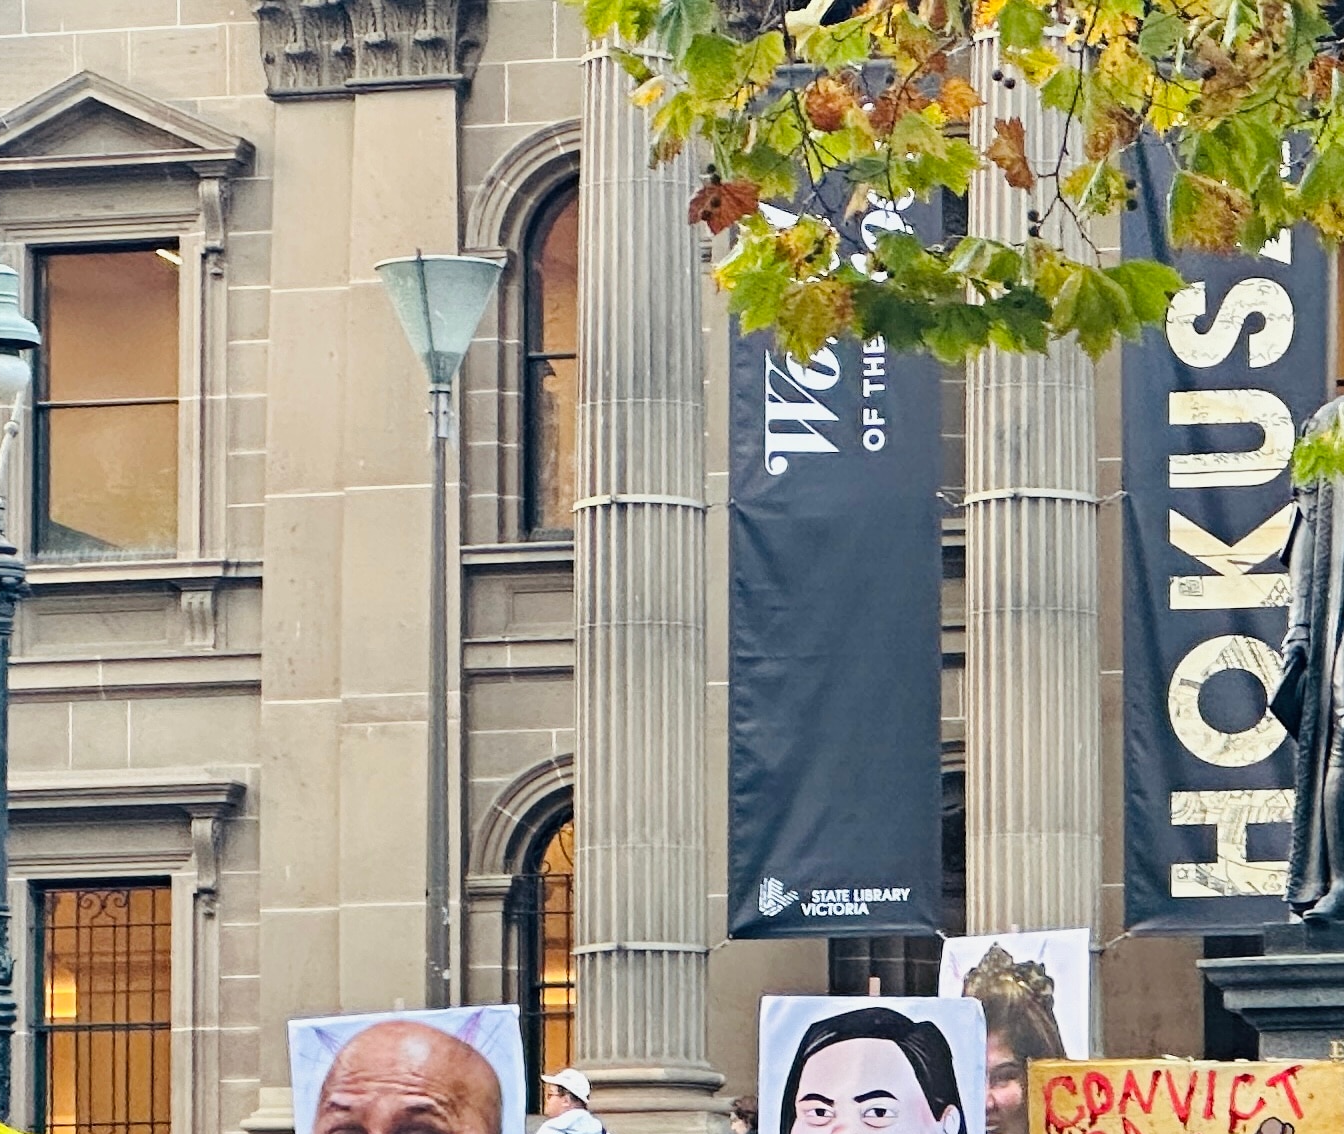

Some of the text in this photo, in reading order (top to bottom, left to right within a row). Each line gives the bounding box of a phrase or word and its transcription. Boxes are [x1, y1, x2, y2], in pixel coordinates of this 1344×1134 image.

[862, 408, 886, 451] OF
[811, 887, 910, 904] STATE LIBRARY
[800, 902, 869, 917] VICTORIA
